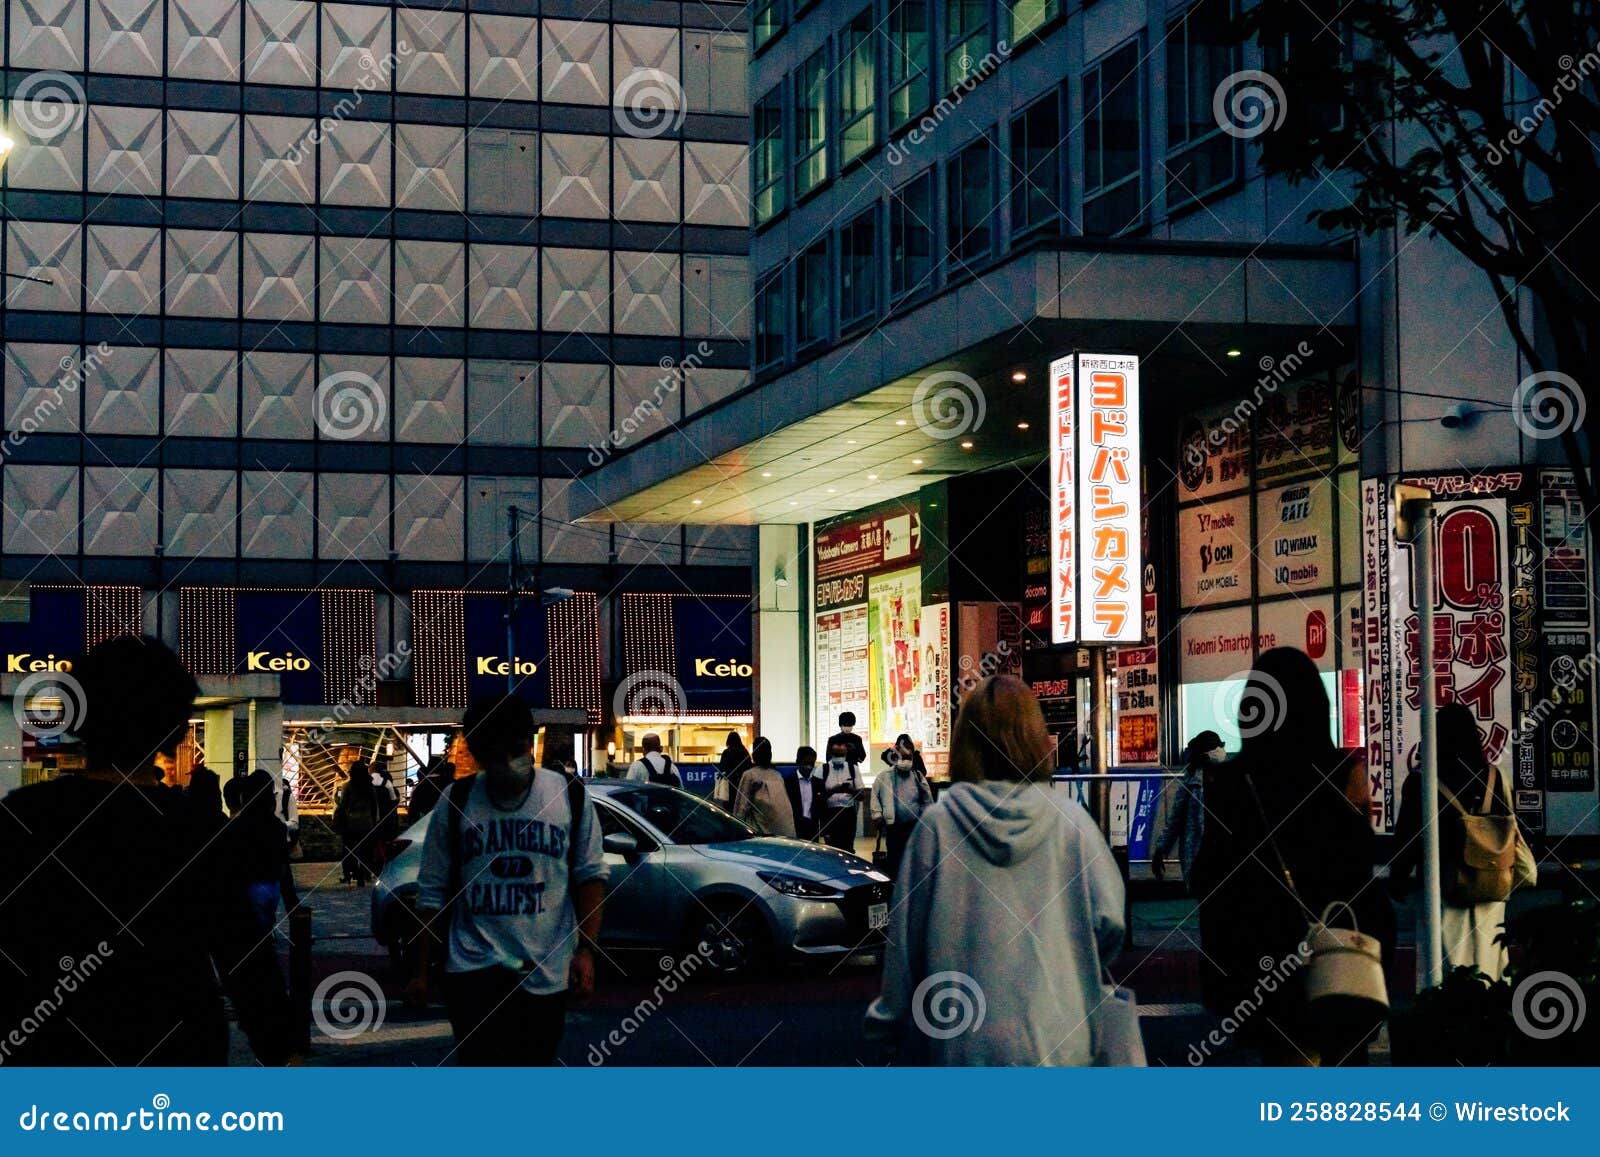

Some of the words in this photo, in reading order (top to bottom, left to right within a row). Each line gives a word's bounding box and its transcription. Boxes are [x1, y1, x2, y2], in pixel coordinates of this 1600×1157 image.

[1080, 358, 1136, 371] 新宿西口本店
[1057, 373, 1073, 639] ヨドバシカメラ
[1088, 371, 1131, 638] ヨドバシカメラ
[1281, 502, 1309, 523] GATE
[1214, 544, 1233, 562] OCN
[1274, 538, 1289, 558] UQ
[1275, 566, 1289, 586] UQ
[1290, 563, 1319, 581] mobile
[1186, 635, 1217, 656] Xiaomi
[1218, 632, 1276, 653] Smartpone
[7, 654, 73, 673] Keio
[247, 651, 311, 671] Keio
[477, 656, 537, 675] Keio
[695, 658, 753, 677] Keio
[486, 818, 566, 860] ANGELES
